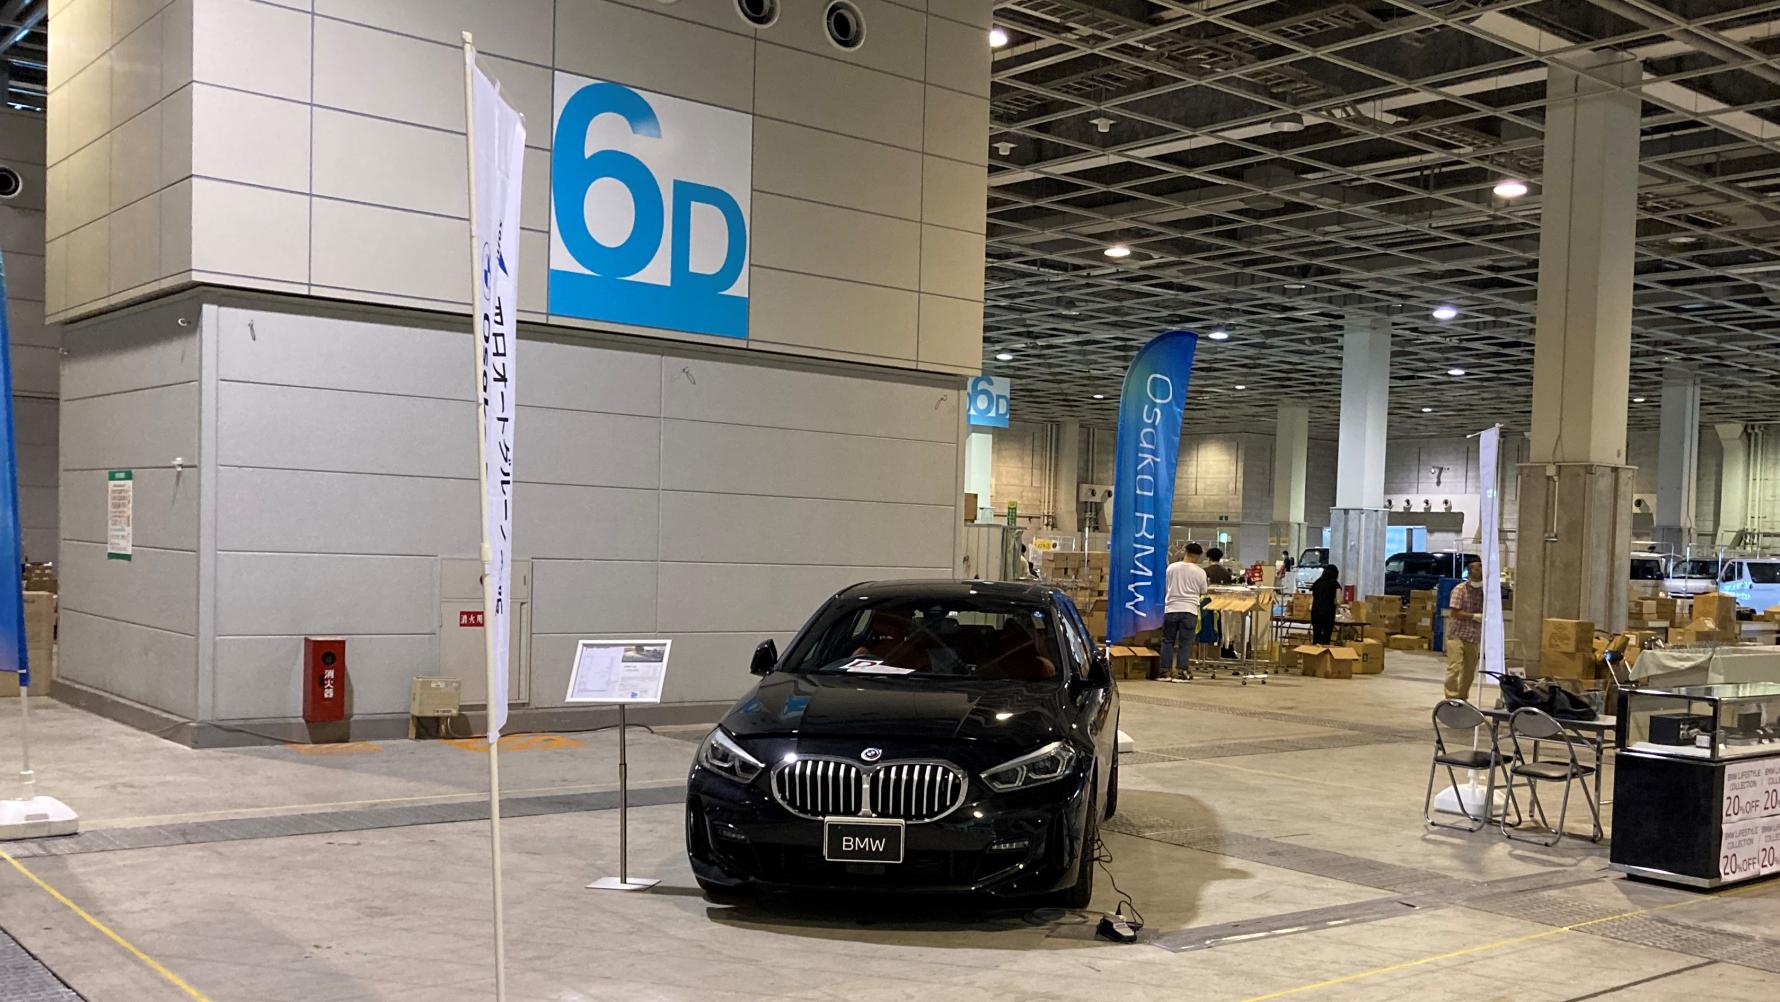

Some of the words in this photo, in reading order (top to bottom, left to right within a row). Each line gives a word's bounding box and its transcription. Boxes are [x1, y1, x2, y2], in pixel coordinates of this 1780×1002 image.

[552, 82, 747, 295] 6D
[971, 375, 1009, 417] 6D
[1135, 373, 1174, 497] Osaka
[323, 669, 335, 699] 消火器
[1730, 780, 1757, 791] COLLECTION
[842, 836, 886, 852] BMW
[1727, 838, 1754, 850] COLLECTION
